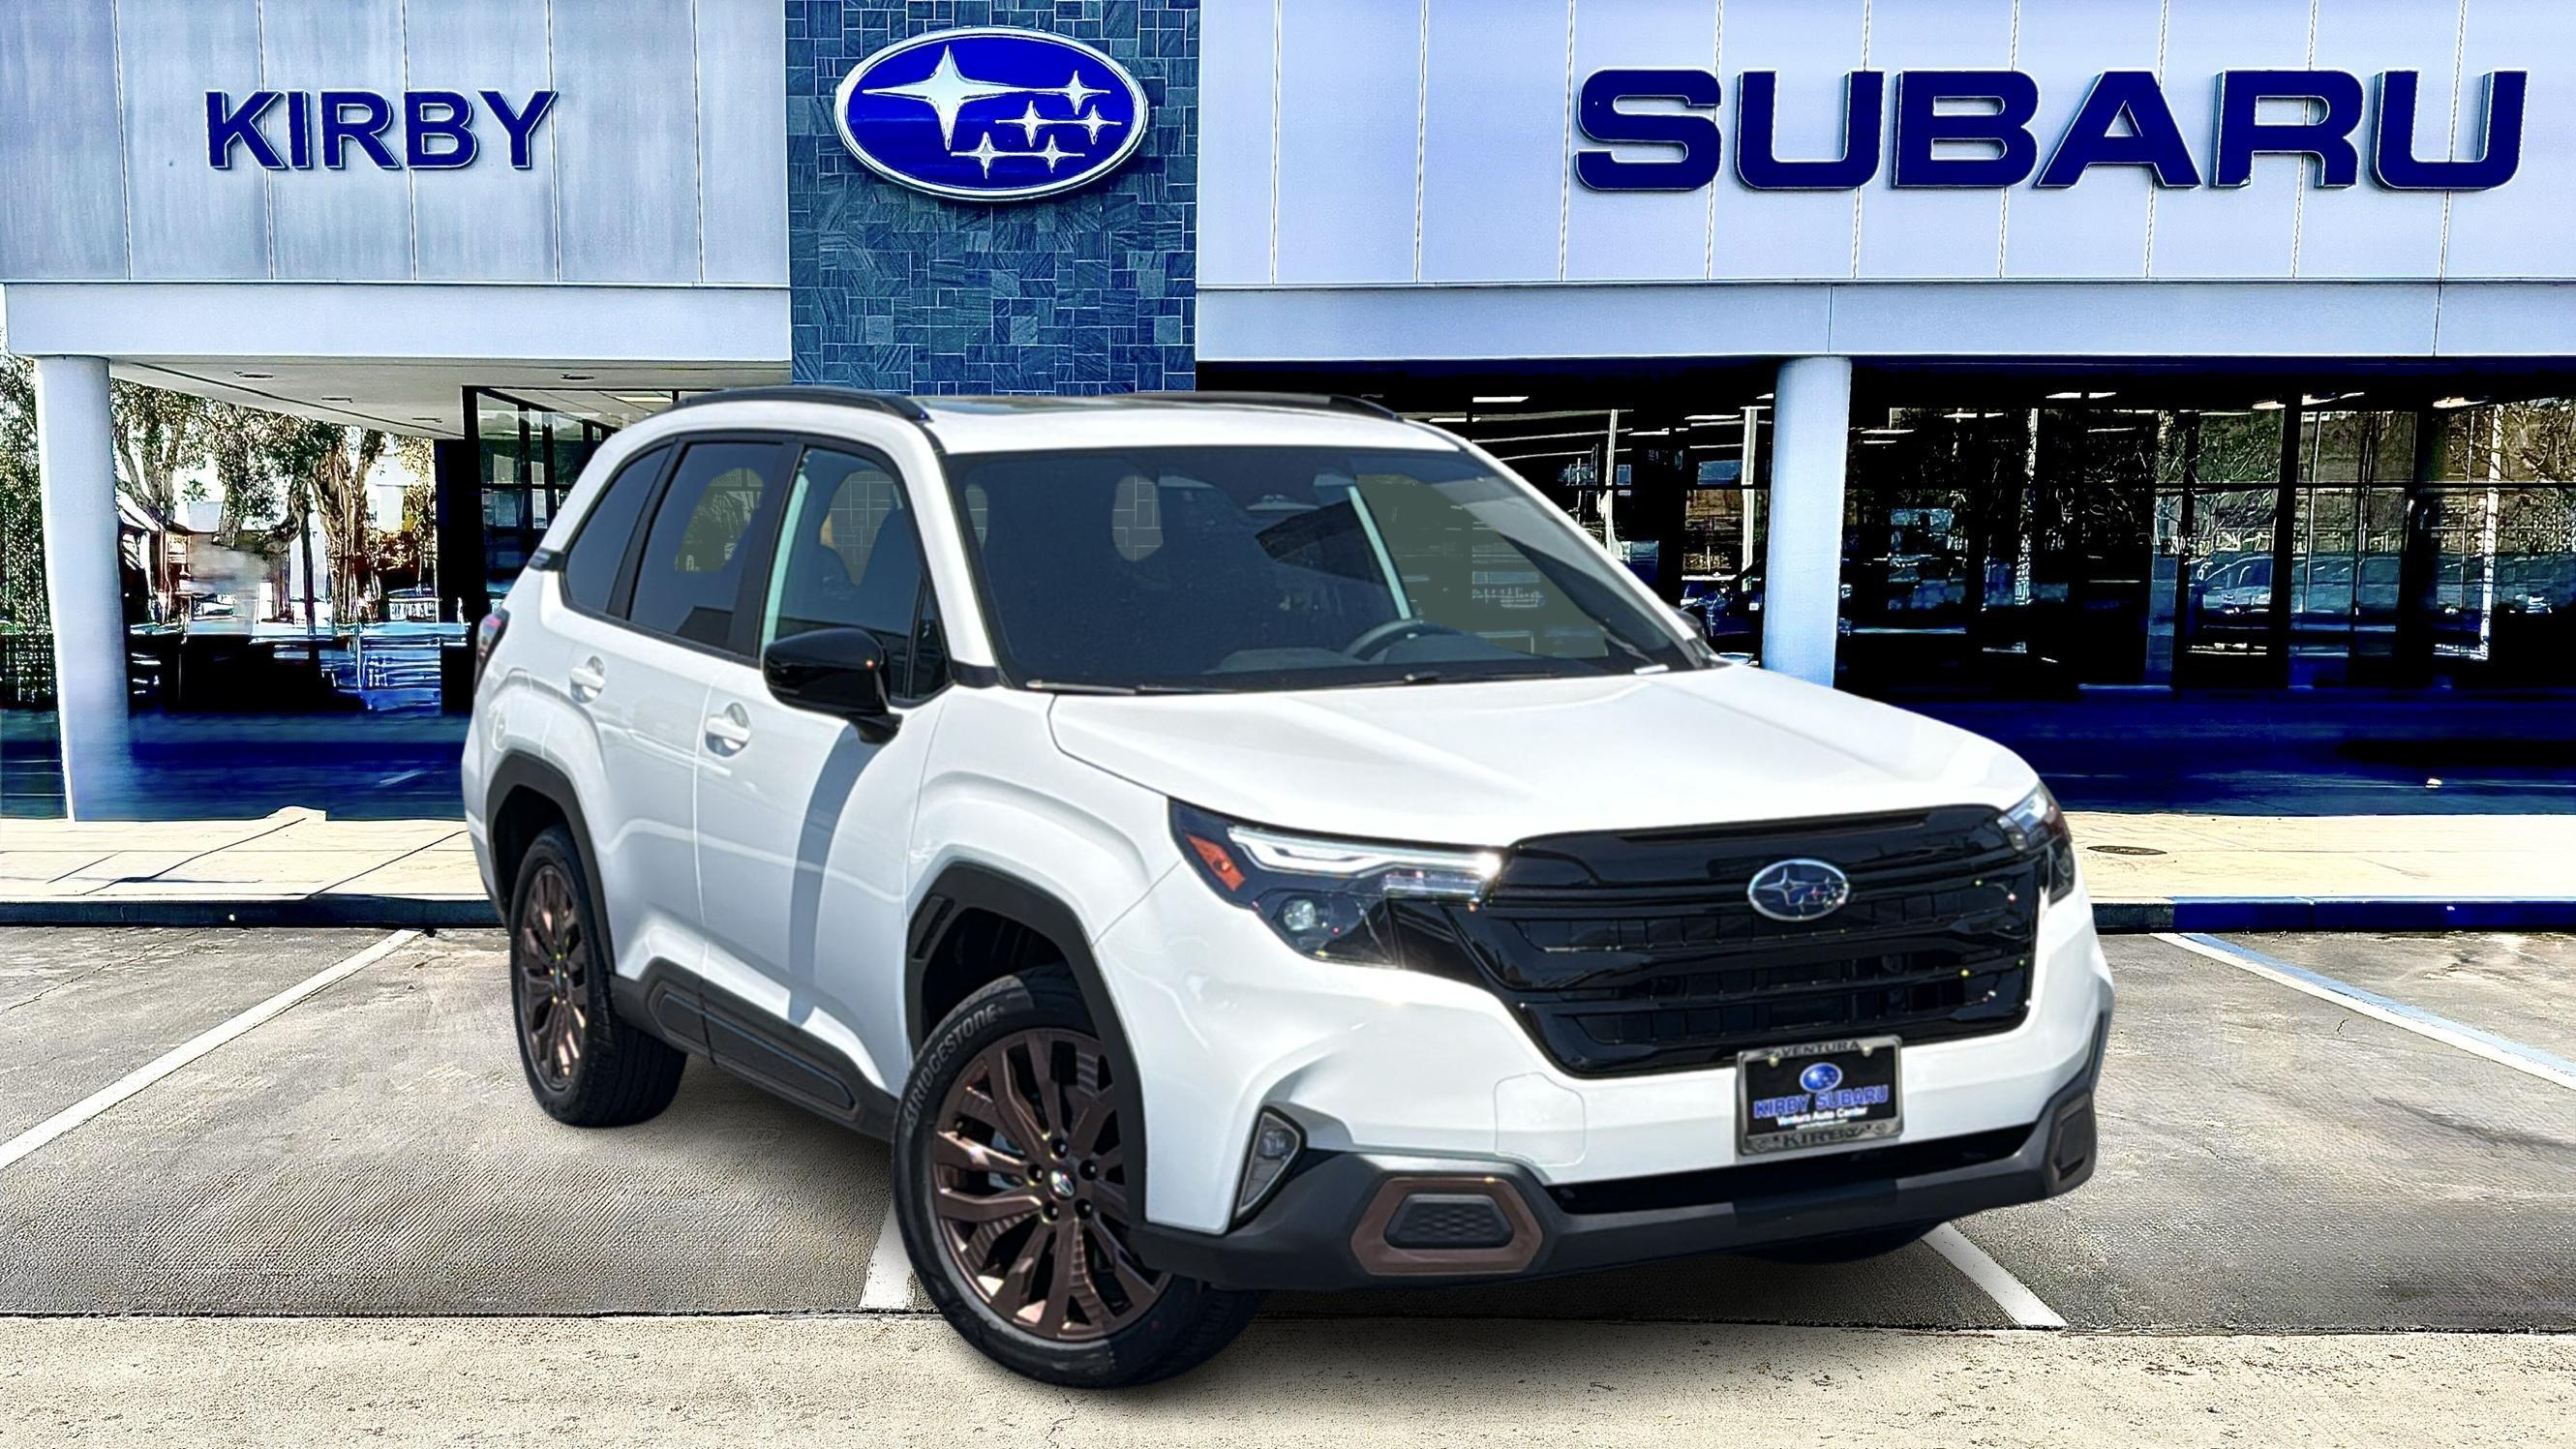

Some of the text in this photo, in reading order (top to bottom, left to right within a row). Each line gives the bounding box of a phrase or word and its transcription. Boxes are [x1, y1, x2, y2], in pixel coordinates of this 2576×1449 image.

[205, 90, 559, 169] KIRBY
[1575, 69, 2528, 190] SUBARU
[1780, 1041, 1860, 1057] VENTURA
[1753, 1085, 1889, 1118] KIRBY SUBARU
[1776, 1113, 1811, 1127] Ventura
[1812, 1109, 1835, 1121] Auto
[1836, 1105, 1868, 1118] Center
[1783, 1127, 1861, 1147] KIRBY
